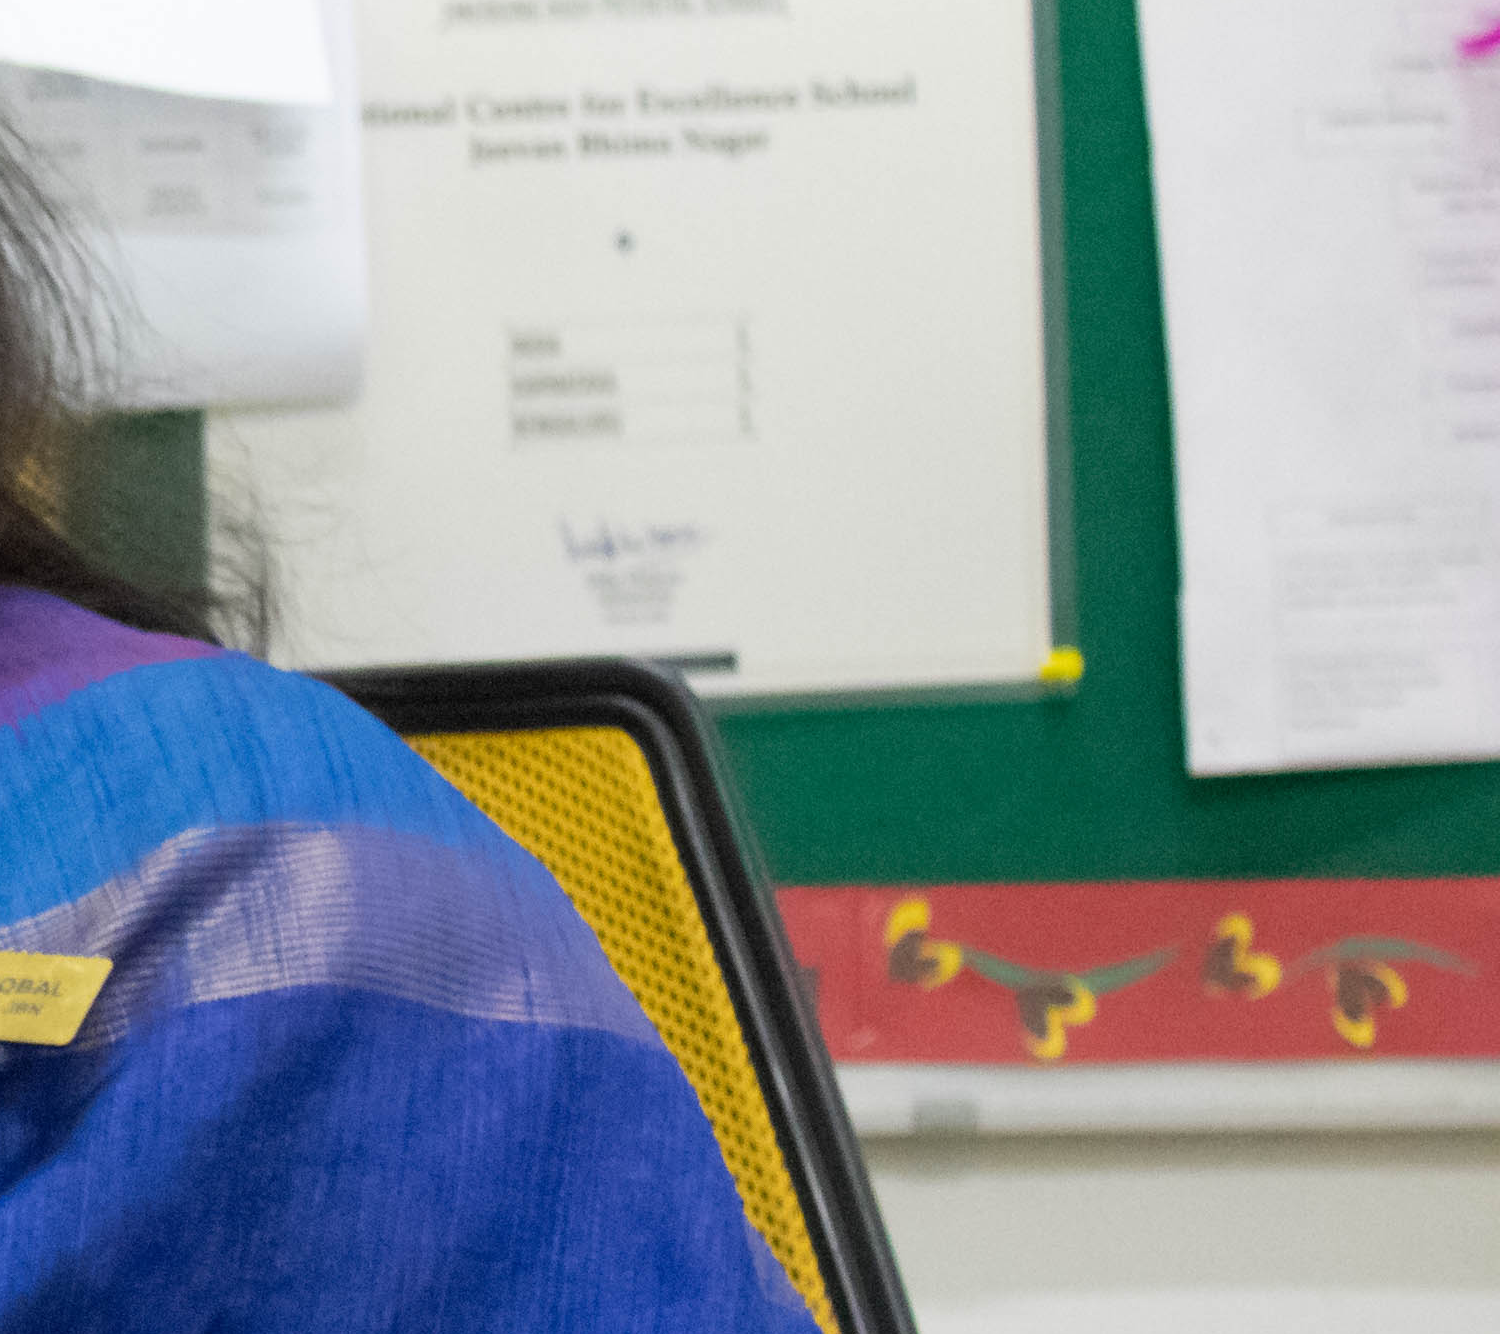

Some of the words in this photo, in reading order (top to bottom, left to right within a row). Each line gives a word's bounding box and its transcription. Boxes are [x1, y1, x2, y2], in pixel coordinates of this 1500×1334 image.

[467, 89, 570, 126] Centre
[581, 87, 627, 121] for
[638, 82, 798, 117] Excellence
[809, 76, 917, 110] School
